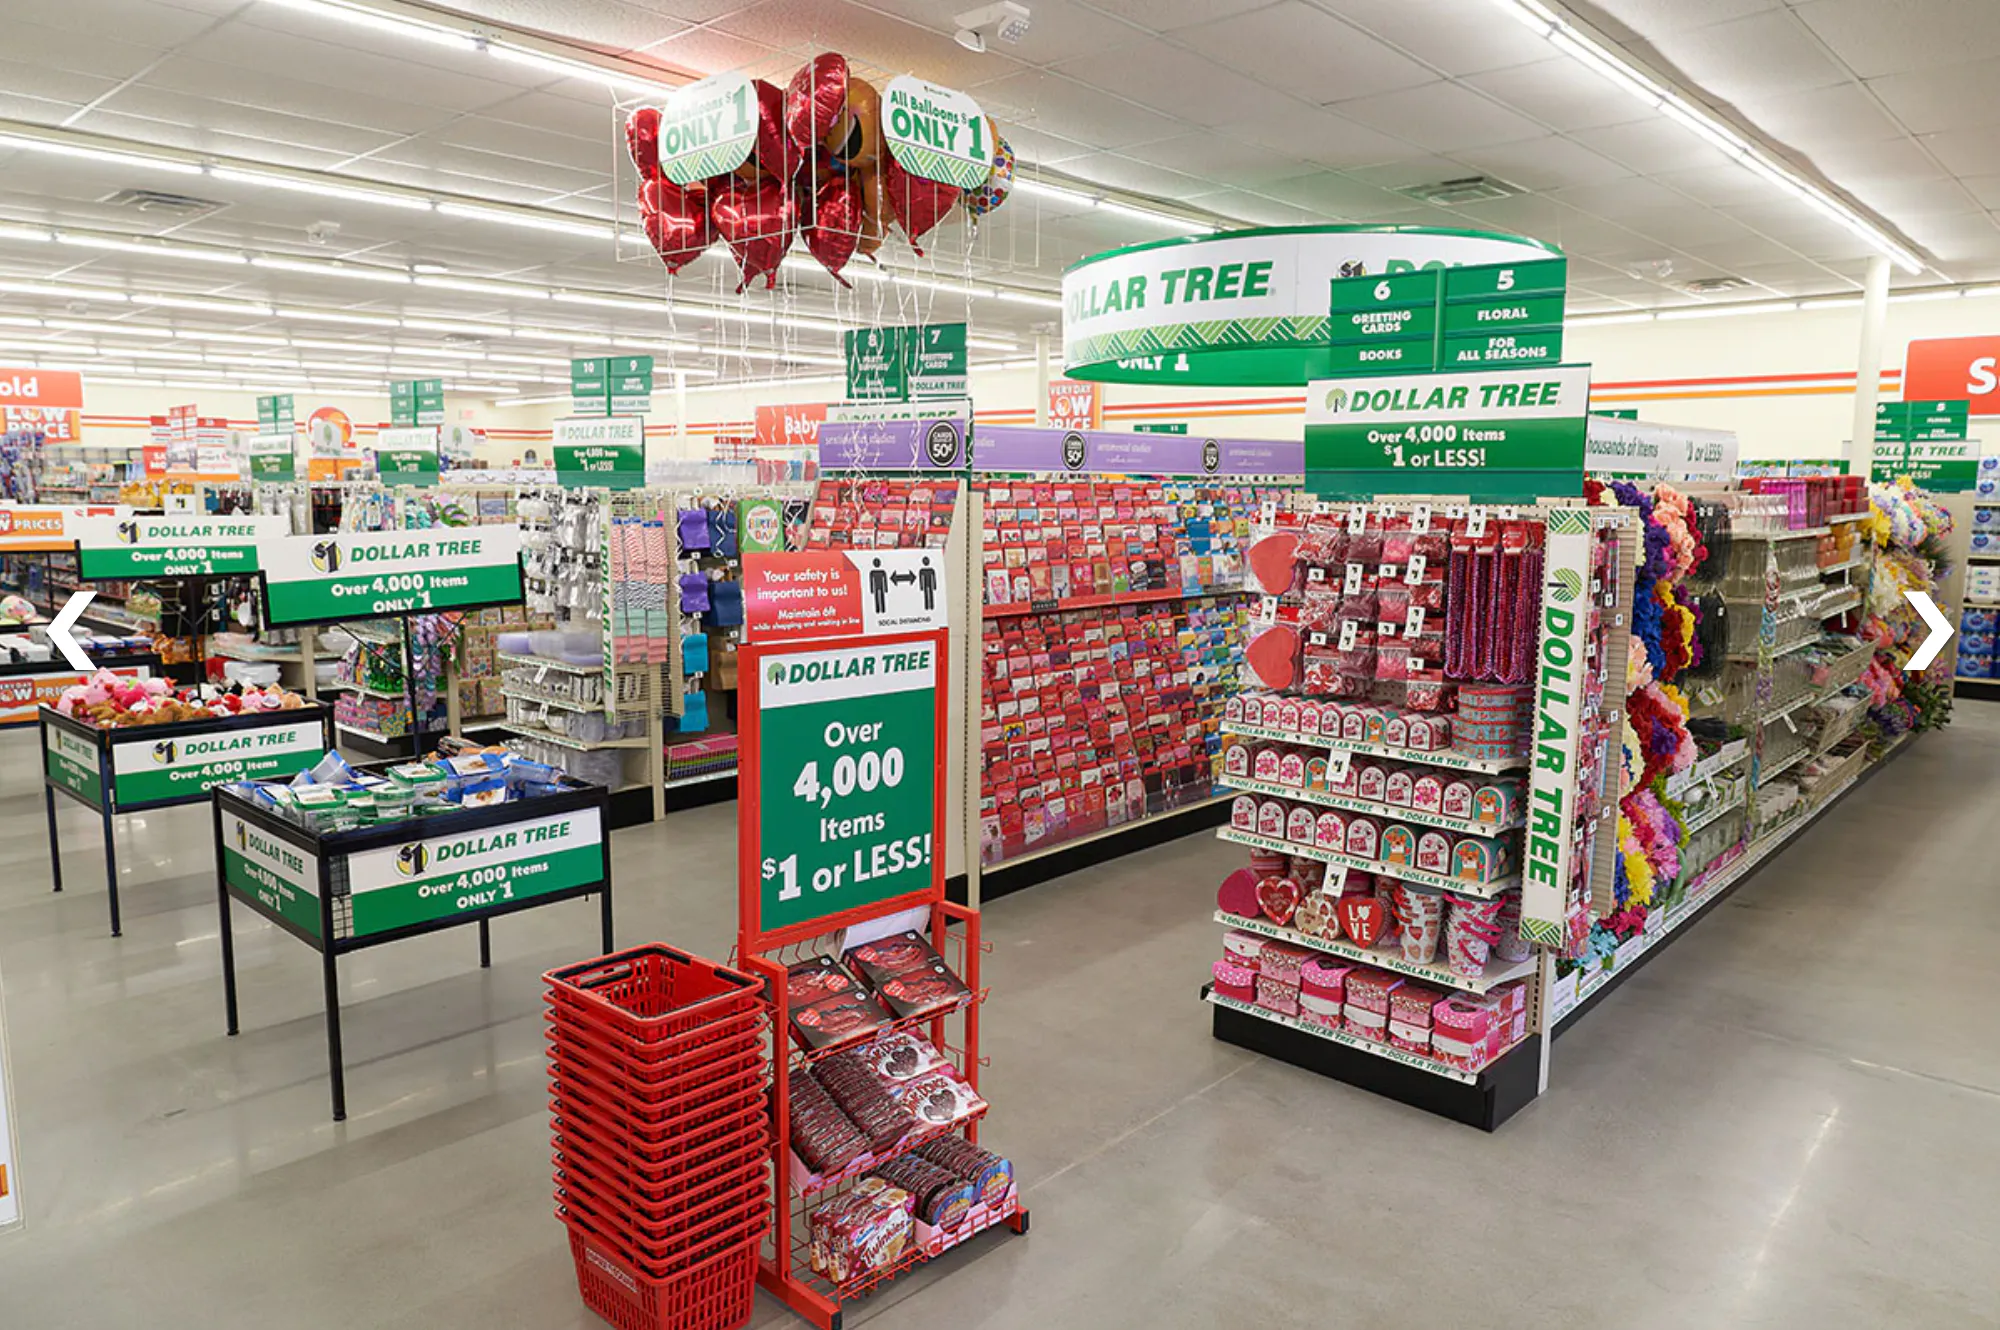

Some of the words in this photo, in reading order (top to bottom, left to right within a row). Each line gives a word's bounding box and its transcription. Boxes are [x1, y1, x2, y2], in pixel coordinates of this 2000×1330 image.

[890, 89, 910, 106] All
[911, 97, 959, 124] Balloons
[665, 111, 713, 155] ONLY
[891, 106, 958, 151] ONLY
[1373, 280, 1392, 301] 6
[1497, 270, 1516, 291] 5
[1067, 275, 1148, 324] OLLAR
[1159, 261, 1273, 305] TREE
[1352, 310, 1412, 325] GREETING
[1477, 307, 1529, 321] FLORAL
[931, 330, 941, 344] 7
[1361, 320, 1402, 335] CARDS
[1488, 337, 1516, 349] FOR
[1359, 349, 1403, 361] BOOKS
[1457, 350, 1481, 361] ALL
[1485, 346, 1548, 360] SEASONS
[630, 360, 638, 371] 9
[914, 381, 945, 391] DOLLAR
[1048, 395, 1093, 417] LOW
[1350, 386, 1470, 412] DOLLAR
[1480, 382, 1561, 408] TREE
[568, 426, 605, 440] DOLLAR
[608, 424, 635, 438] TREE
[784, 413, 820, 440] Baby
[1367, 430, 1401, 444] Over
[1404, 425, 1457, 445] 4,000
[1463, 428, 1506, 441] Items
[1384, 444, 1406, 467] $1
[1410, 454, 1431, 466] or
[1434, 447, 1486, 466] LESS!
[1929, 445, 1968, 457] TREE
[13, 519, 63, 532] PRICES
[147, 525, 213, 538] DOLLAR
[214, 525, 256, 537] TREE
[131, 551, 162, 562] Over
[164, 547, 208, 562] 4,000
[210, 548, 244, 560] Items
[350, 543, 432, 563] DOLLAR
[436, 540, 482, 557] TREE
[164, 564, 199, 575] ONLY
[762, 569, 790, 583] Your
[793, 567, 828, 584] safety
[830, 567, 841, 579] is
[331, 584, 369, 597] Over
[371, 573, 425, 595] 4,000
[429, 574, 469, 589] Items
[600, 543, 612, 632] DOLLAR
[757, 587, 815, 602] important
[816, 586, 828, 598] to
[830, 584, 848, 597] us!
[372, 599, 415, 614] ONLY
[777, 607, 821, 621] Maintain
[789, 656, 876, 684] DOLLAR
[881, 650, 930, 674] TREE
[1536, 605, 1576, 776] DOLLAR
[185, 740, 252, 757] DOLLAR
[257, 730, 297, 747] TREE
[823, 720, 883, 748] Over
[1316, 738, 1350, 750] DOLLAR
[1405, 751, 1442, 764] DOLLAR
[1444, 757, 1470, 768] TREE
[169, 771, 200, 781] Over
[201, 761, 243, 777] 4,000
[246, 760, 279, 772] Items
[793, 746, 905, 810] 4,000
[1316, 794, 1350, 807] DOLLAR
[820, 811, 886, 843] Items
[1405, 811, 1443, 826] DOLLAR
[1444, 819, 1470, 830] TREE
[435, 832, 518, 863] DOLLAR
[523, 821, 571, 845] TREE
[1528, 785, 1565, 890] TREE
[249, 832, 281, 863] DOLLAR
[281, 849, 304, 875] TREE
[1313, 849, 1348, 864] DOLLAR
[761, 853, 801, 902] $1
[812, 862, 848, 893] or
[853, 832, 933, 883] LESS!
[417, 880, 455, 898] Over
[456, 866, 506, 890] 4,000
[511, 860, 549, 878] Items
[1403, 870, 1440, 885] DOLLAR
[1441, 879, 1466, 891] TREE
[456, 889, 496, 909] ONLY
[1307, 938, 1341, 953] DOLLAR
[1395, 961, 1431, 977] DOLLAR
[1432, 971, 1456, 984] TREE
[1300, 1021, 1332, 1037] DOLLAR
[1388, 1050, 1424, 1066] DOLLAR
[1425, 1060, 1450, 1074] TREE
